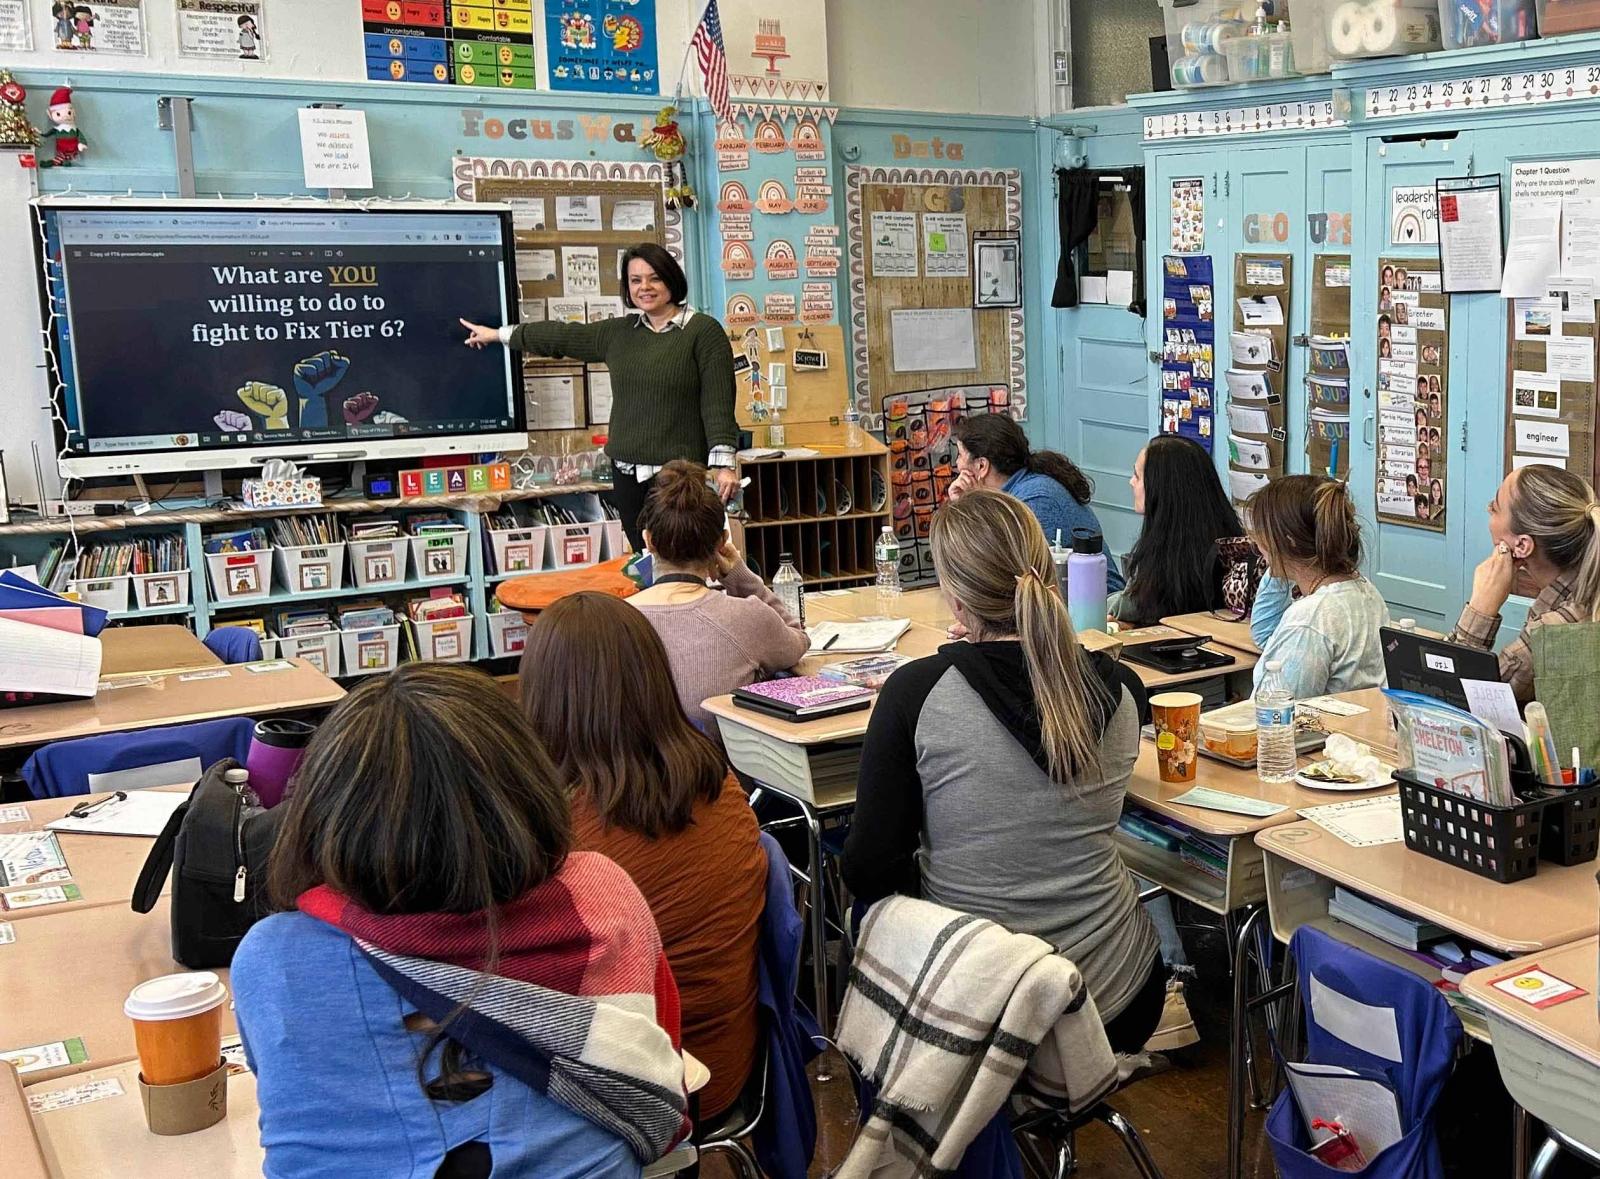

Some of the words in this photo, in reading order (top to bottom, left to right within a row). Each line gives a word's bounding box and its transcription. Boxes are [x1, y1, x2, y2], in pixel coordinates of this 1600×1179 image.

[200, 2, 256, 13] Respectful
[1372, 91, 1379, 104] 21
[1389, 89, 1398, 101] 22
[1407, 88, 1417, 100] 23
[1423, 85, 1432, 98] 24
[1443, 83, 1453, 96] 25
[1462, 81, 1473, 94] 26
[1481, 79, 1490, 93] 27
[1501, 77, 1512, 91] 28
[1523, 75, 1534, 89] 29
[1541, 73, 1554, 87] 30
[1565, 70, 1575, 85] 31
[1588, 68, 1600, 82] 32
[1174, 116, 1178, 126] 2
[1183, 115, 1188, 125] 3
[1198, 113, 1202, 124] 4
[1215, 113, 1219, 123] 5
[1225, 112, 1230, 122] 6
[1241, 110, 1245, 120] 7
[1255, 109, 1260, 120] 8
[1266, 107, 1271, 118] 9
[1280, 105, 1287, 117] 10
[1297, 104, 1302, 115] 11
[1308, 105, 1315, 116] 12
[1325, 103, 1332, 114] 13
[462, 110, 574, 140] Focus
[578, 115, 654, 144] Wa
[892, 134, 964, 160] Data
[1577, 178, 1595, 186] yellow
[1422, 205, 1439, 219] role
[212, 267, 279, 284] What
[284, 269, 323, 284] are
[328, 266, 377, 284] YOU
[208, 294, 293, 316] willing
[300, 296, 322, 311] to
[328, 293, 357, 311] do
[363, 295, 385, 311] to
[192, 323, 249, 346] fight
[254, 325, 278, 341] to
[285, 322, 321, 340] Fix
[325, 321, 375, 339] Tier
[380, 320, 405, 337] 6?
[1314, 350, 1345, 367] ROUP
[1316, 384, 1347, 403] ROUP
[1527, 433, 1558, 443] engineer
[407, 468, 505, 486] LEARN
[1414, 728, 1464, 756] SKELETON
